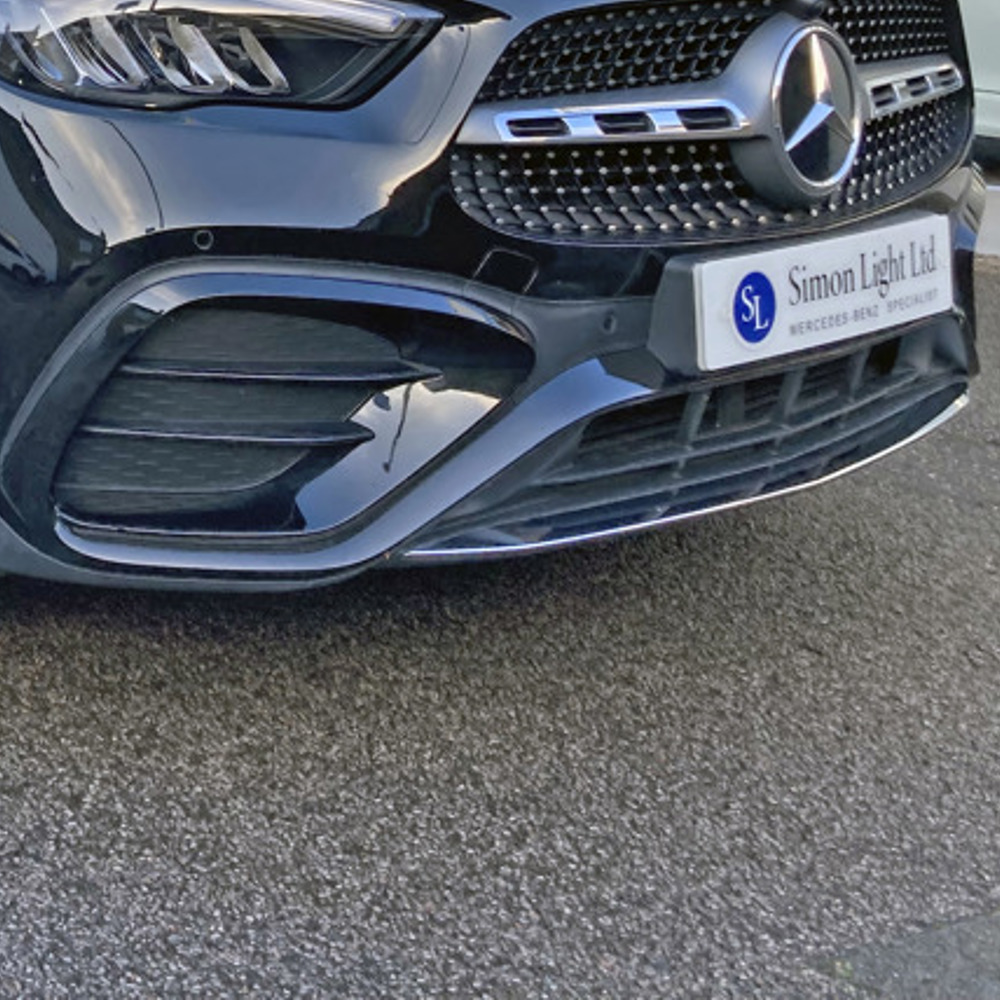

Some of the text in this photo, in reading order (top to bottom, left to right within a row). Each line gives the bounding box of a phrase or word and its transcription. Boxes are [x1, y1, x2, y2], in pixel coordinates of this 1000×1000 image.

[788, 265, 855, 306] Simon
[860, 245, 906, 298] Light
[741, 285, 769, 331] SL
